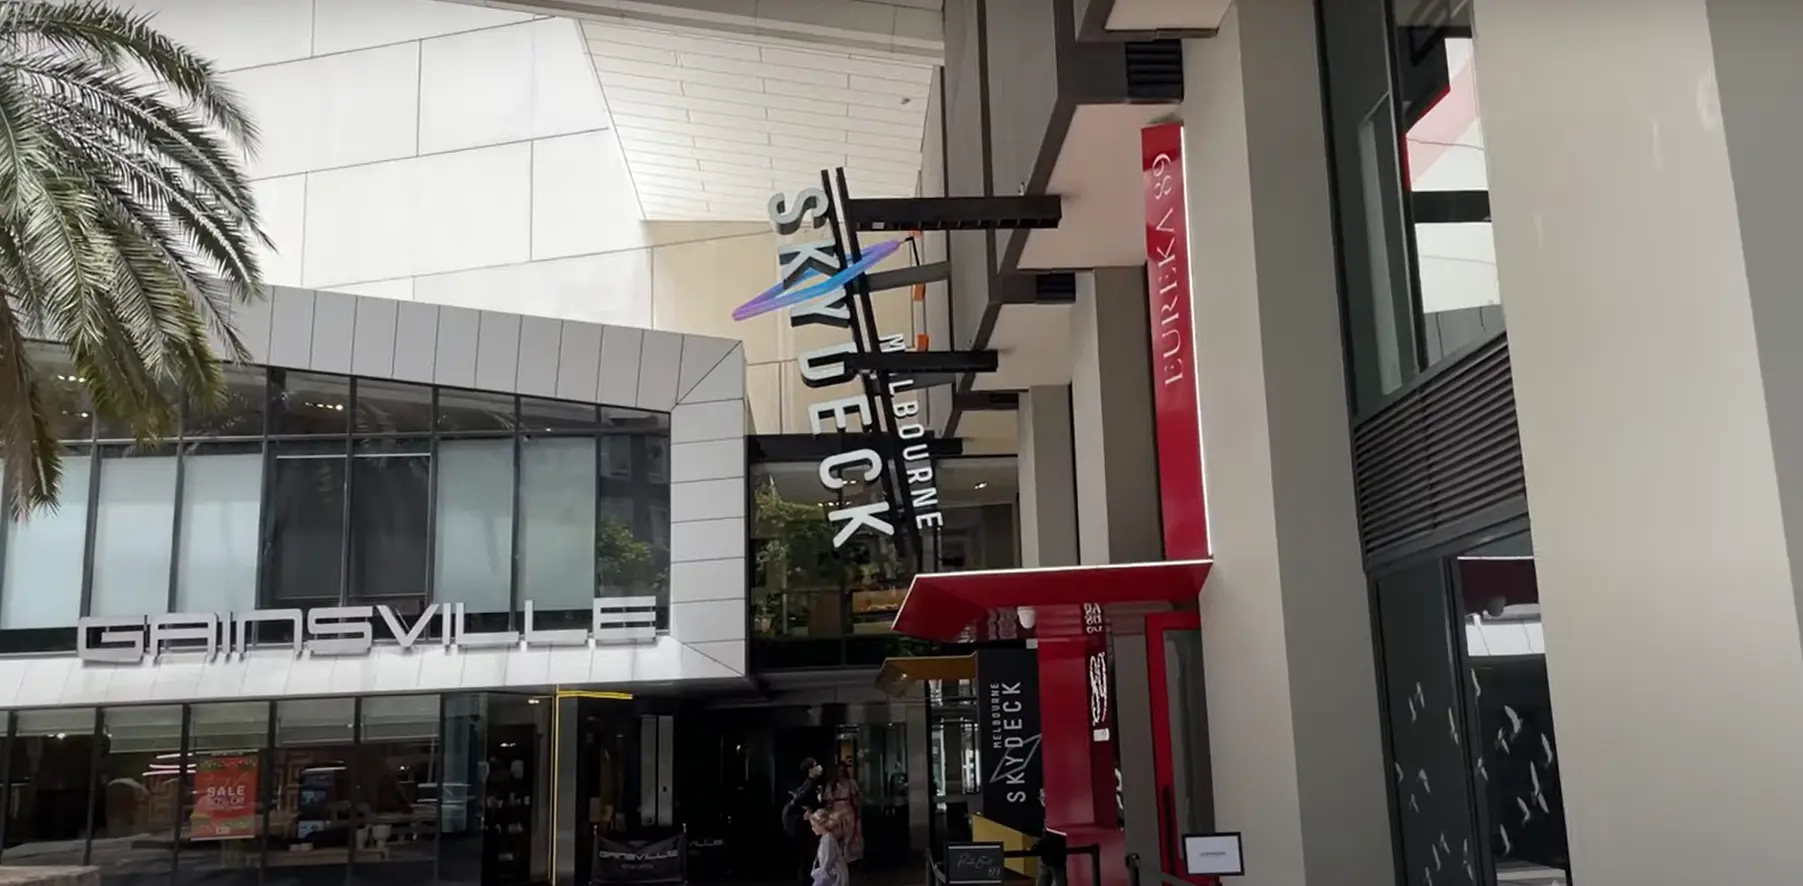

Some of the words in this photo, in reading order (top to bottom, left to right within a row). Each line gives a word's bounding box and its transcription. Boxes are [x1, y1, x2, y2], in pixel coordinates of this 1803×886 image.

[1152, 153, 1172, 200] 89
[1155, 208, 1184, 386] EUREKA
[768, 187, 895, 548] SKYDECK
[878, 333, 943, 529] MLBOURNE
[76, 596, 657, 662] GAINSVILLE
[990, 682, 1003, 749] MELBOURNE
[1001, 681, 1027, 803] SKYDECK
[206, 785, 246, 797] SALE
